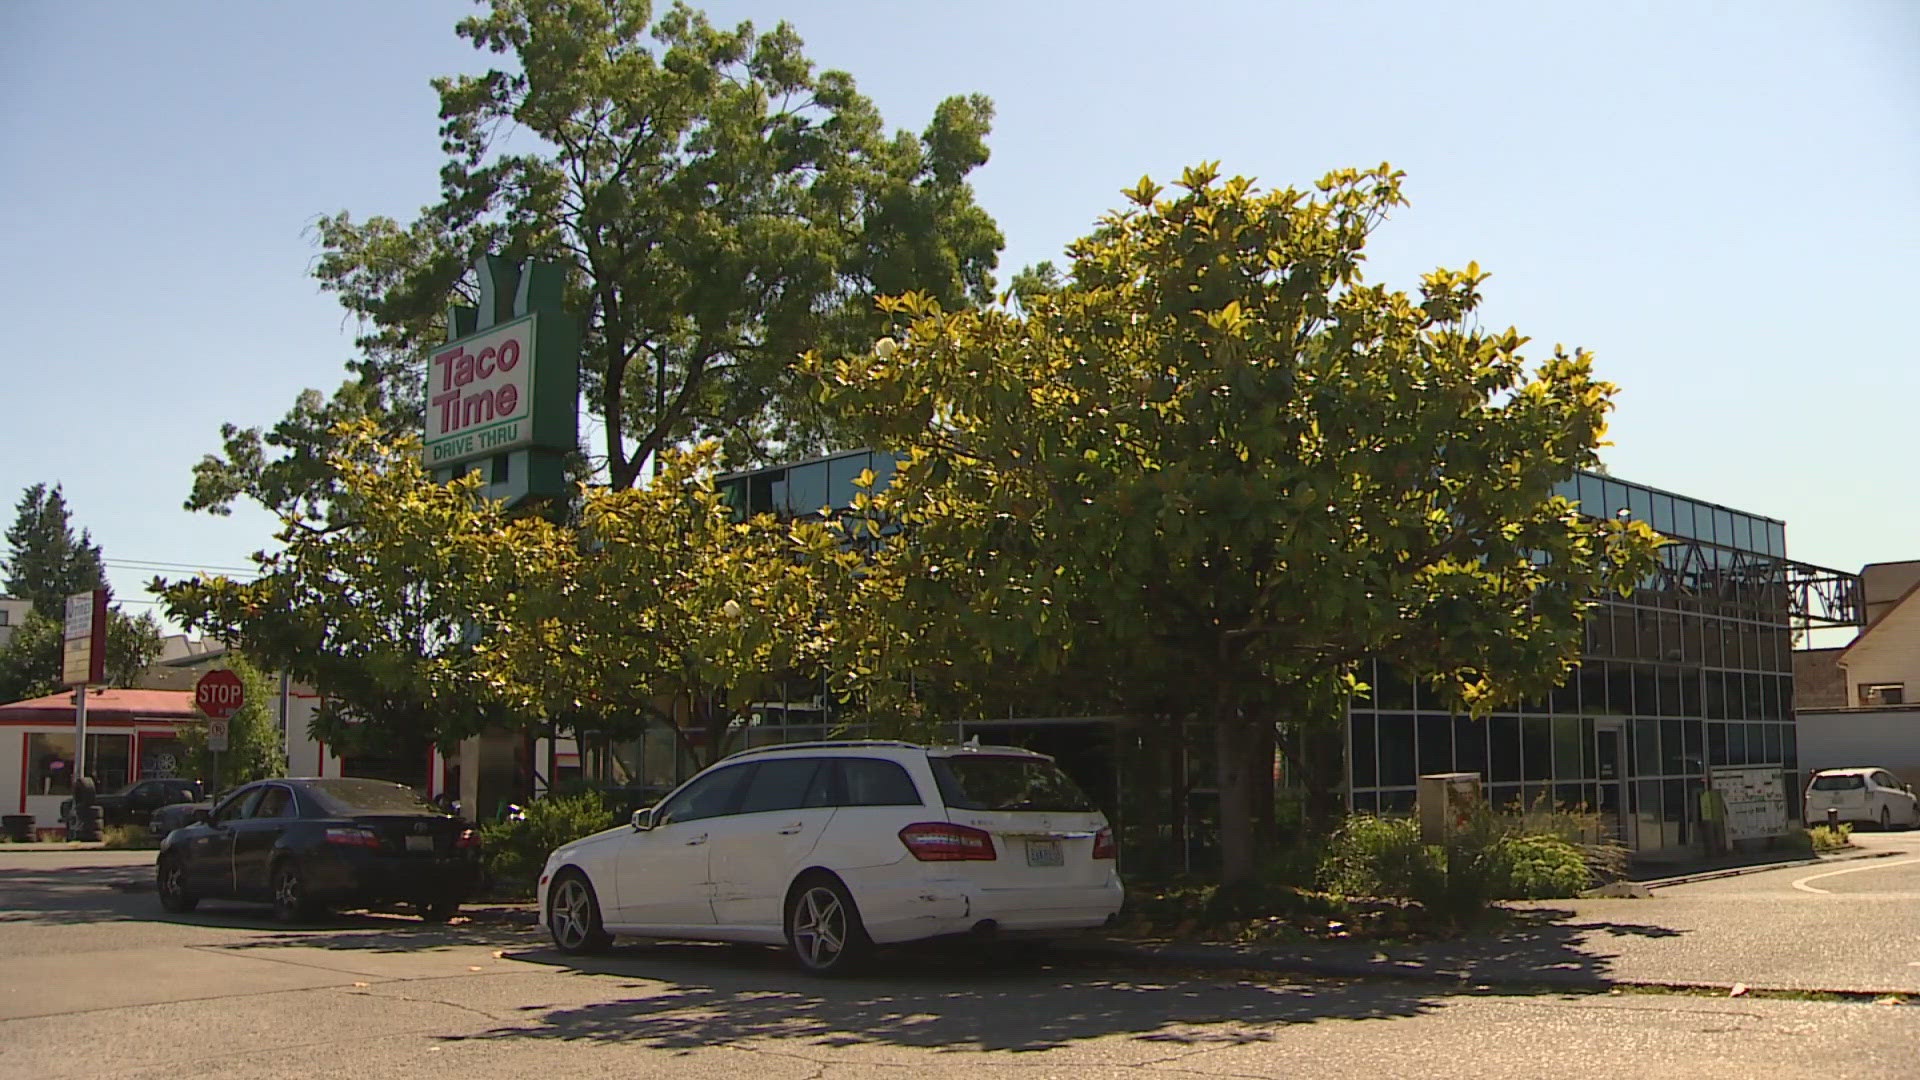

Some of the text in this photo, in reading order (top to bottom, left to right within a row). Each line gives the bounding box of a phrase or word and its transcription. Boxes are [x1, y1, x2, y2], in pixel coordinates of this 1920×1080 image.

[435, 339, 520, 392] Taco
[432, 384, 518, 434] Time
[434, 424, 517, 460] DRIVE THRU
[199, 684, 241, 704] STOP
